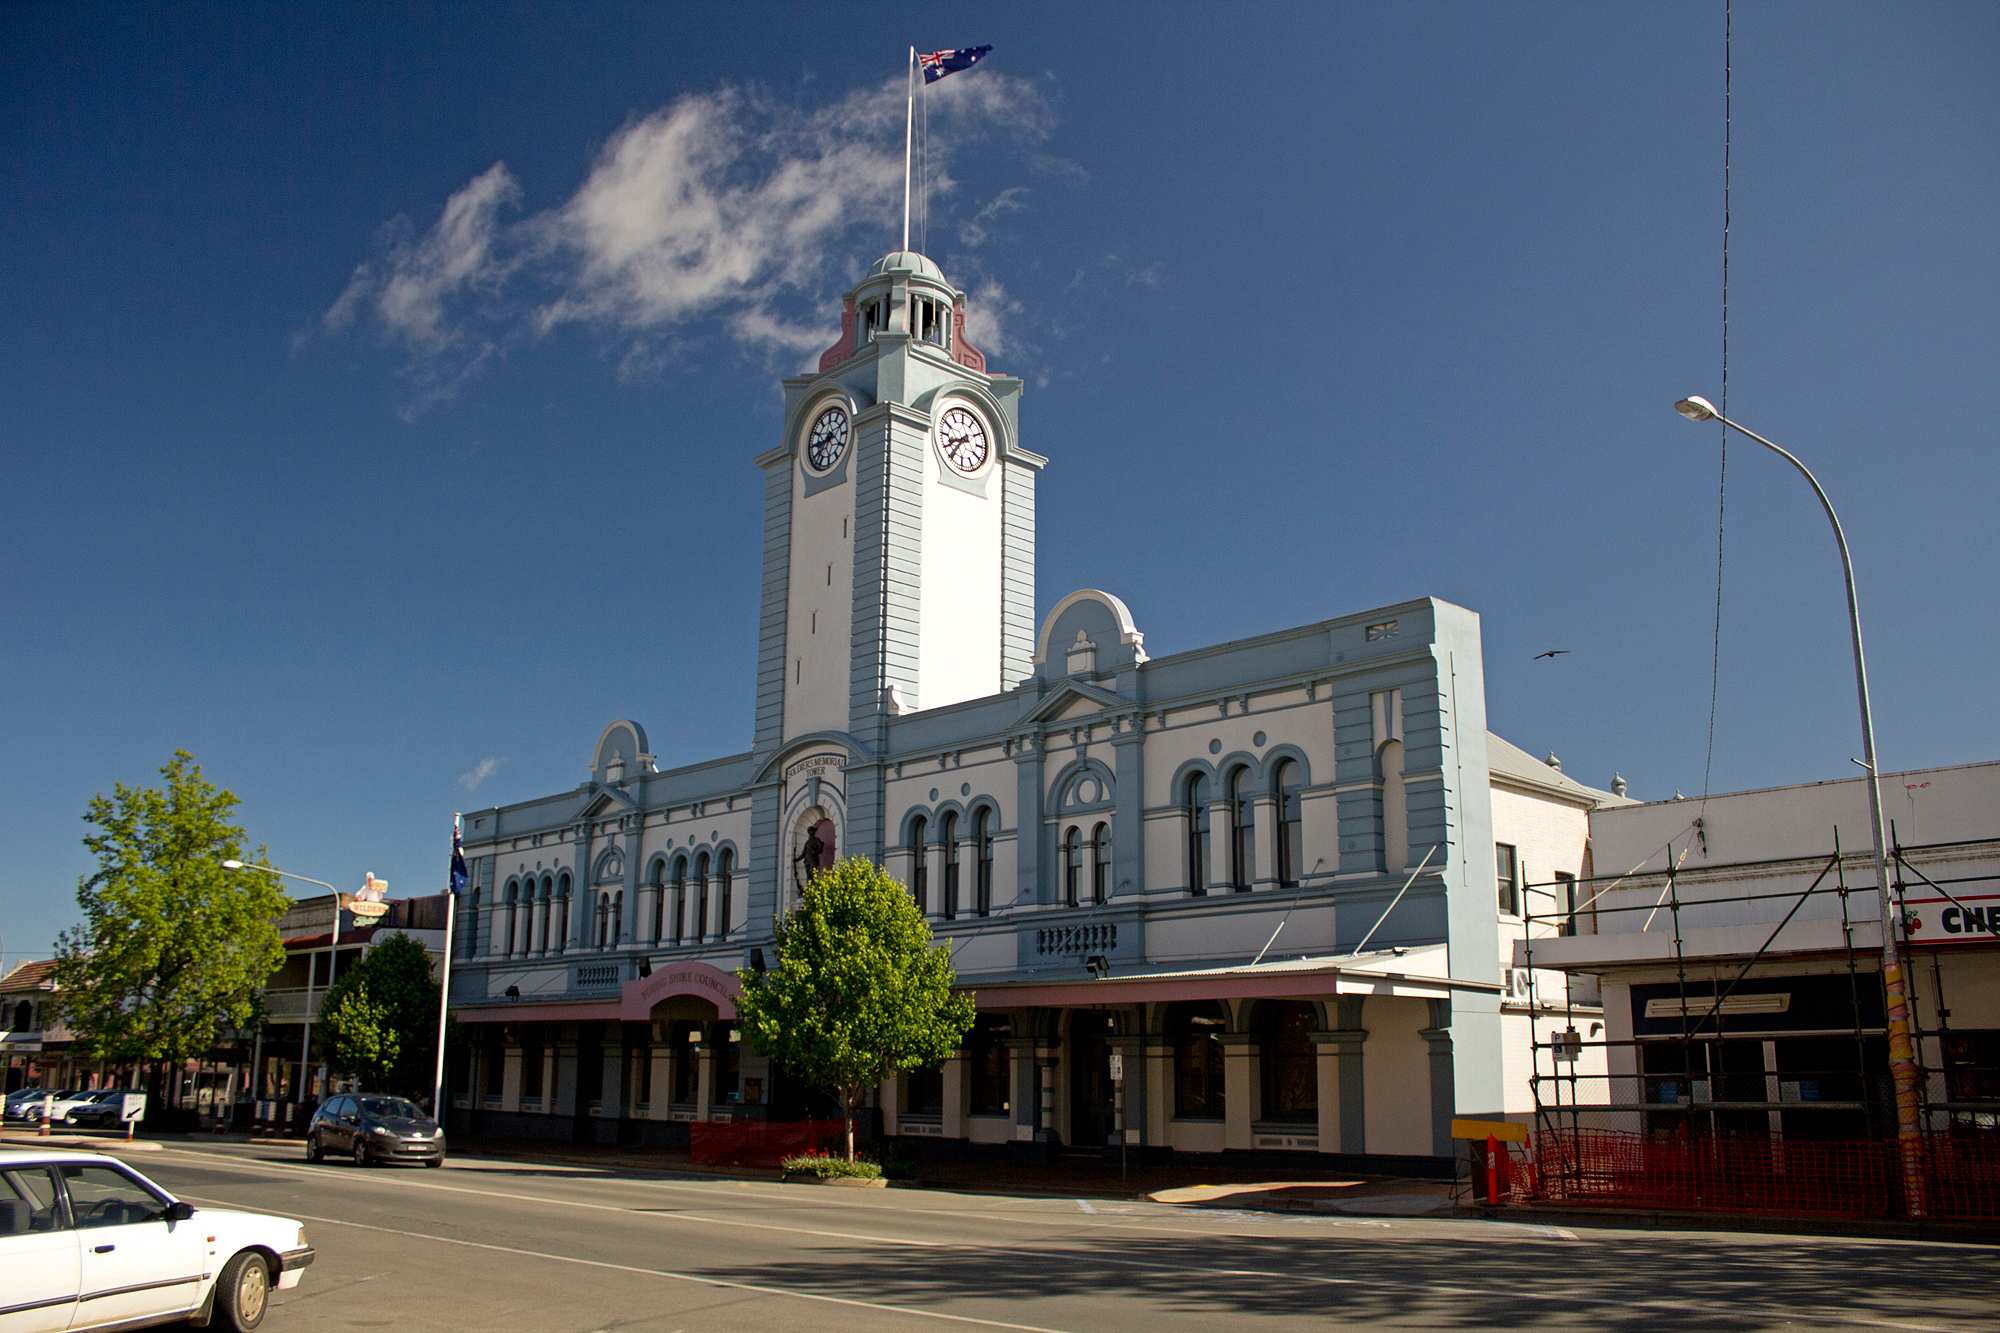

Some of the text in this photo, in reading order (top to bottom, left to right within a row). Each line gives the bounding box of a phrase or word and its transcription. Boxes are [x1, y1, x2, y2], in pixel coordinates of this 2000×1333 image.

[806, 766, 826, 778] TOWER
[669, 972, 692, 985] SHIRE
[694, 972, 728, 999] COUNCIL
